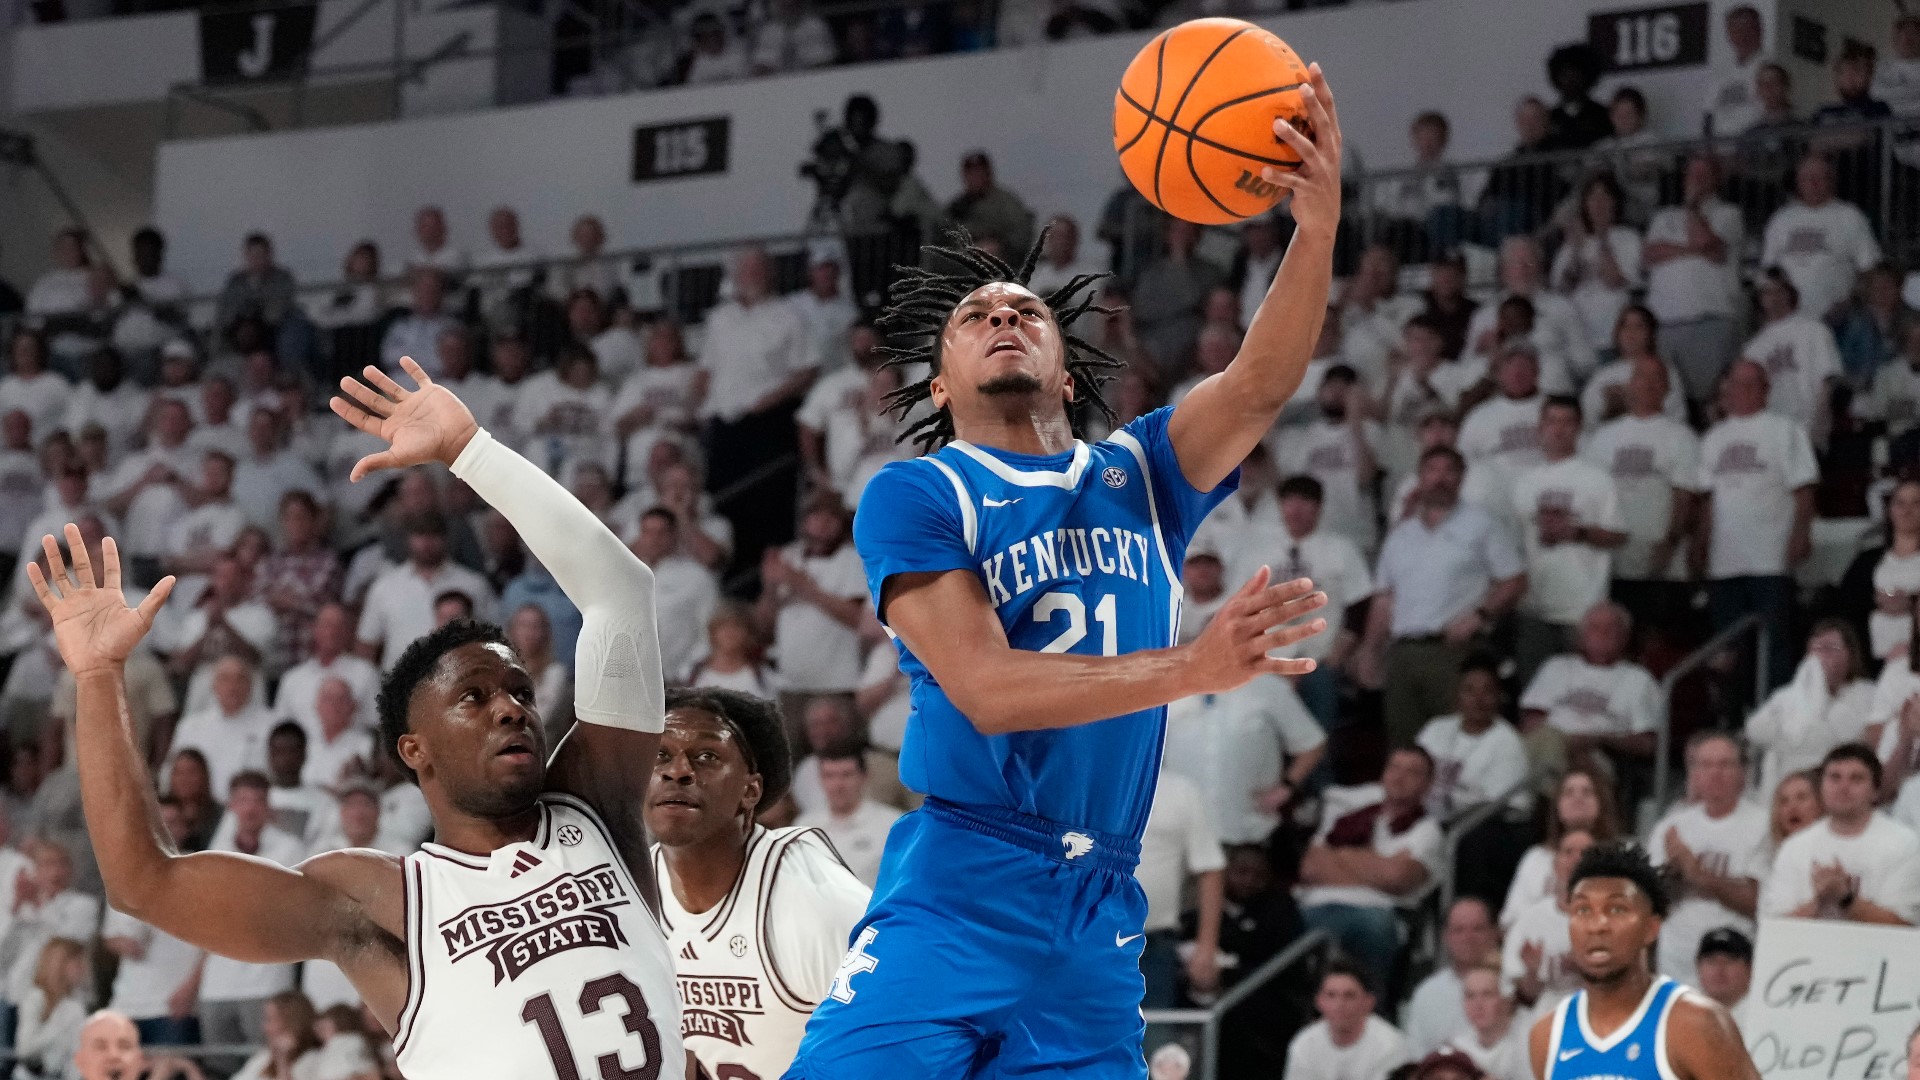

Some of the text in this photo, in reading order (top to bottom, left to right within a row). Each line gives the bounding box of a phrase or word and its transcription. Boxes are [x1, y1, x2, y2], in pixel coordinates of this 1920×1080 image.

[238, 13, 275, 77] J
[1615, 13, 1681, 66] 116
[655, 127, 708, 172] 115
[1103, 467, 1127, 488] SEC
[983, 527, 1149, 608] KENTUCKY
[1032, 592, 1118, 657] 21
[558, 825, 583, 846] SEC
[441, 870, 627, 957] MISSISSIPPI
[511, 919, 607, 967] STATE
[677, 981, 762, 1008] ISSIPPI
[1764, 958, 1920, 1014] GET L
[519, 970, 664, 1080] 13
